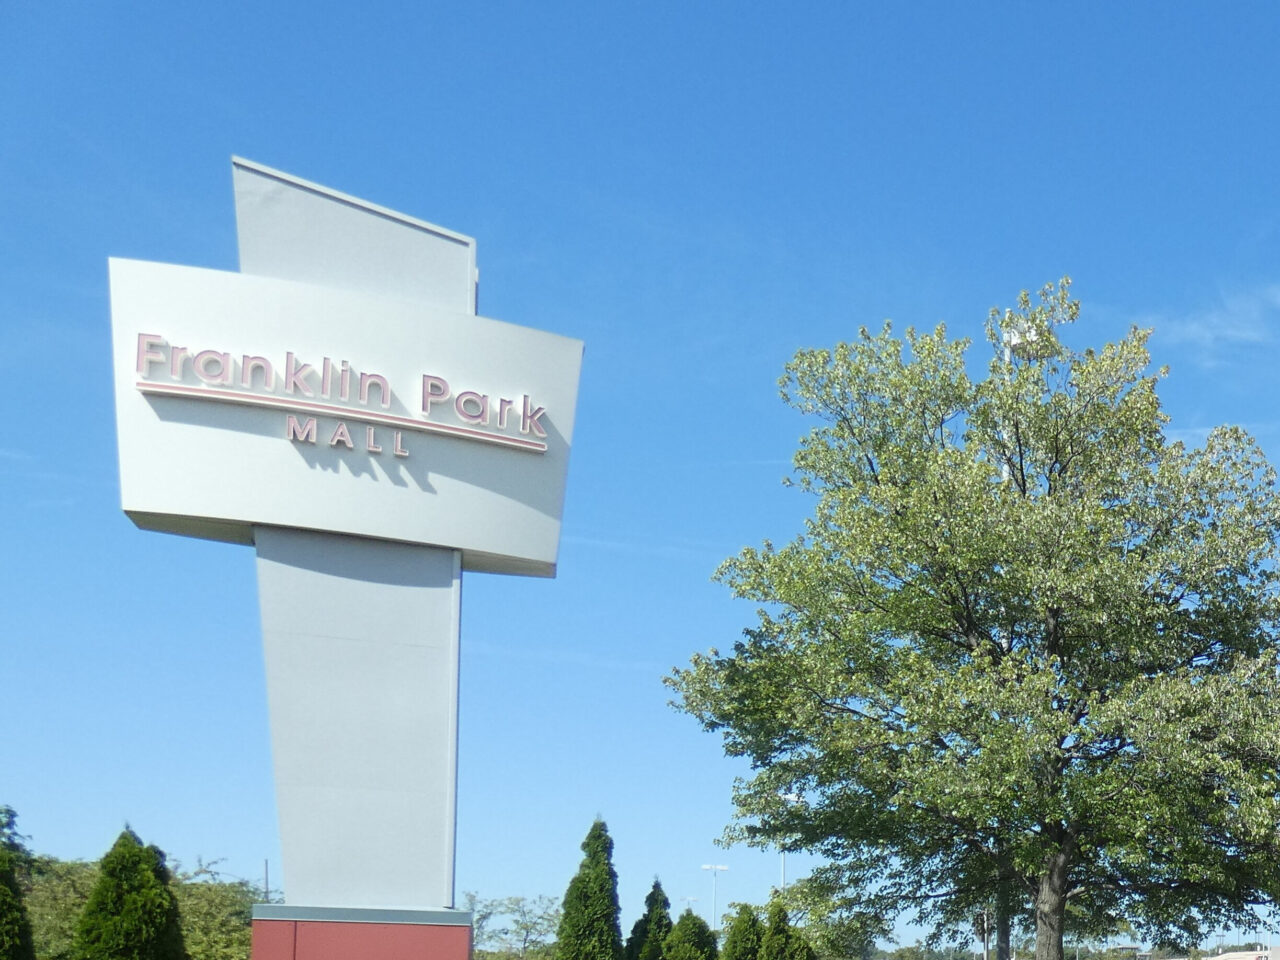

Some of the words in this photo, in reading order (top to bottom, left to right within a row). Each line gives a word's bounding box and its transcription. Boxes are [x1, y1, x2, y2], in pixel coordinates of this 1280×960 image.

[136, 333, 391, 408] Franklin
[421, 374, 547, 438] Park
[286, 415, 409, 456] MALL
